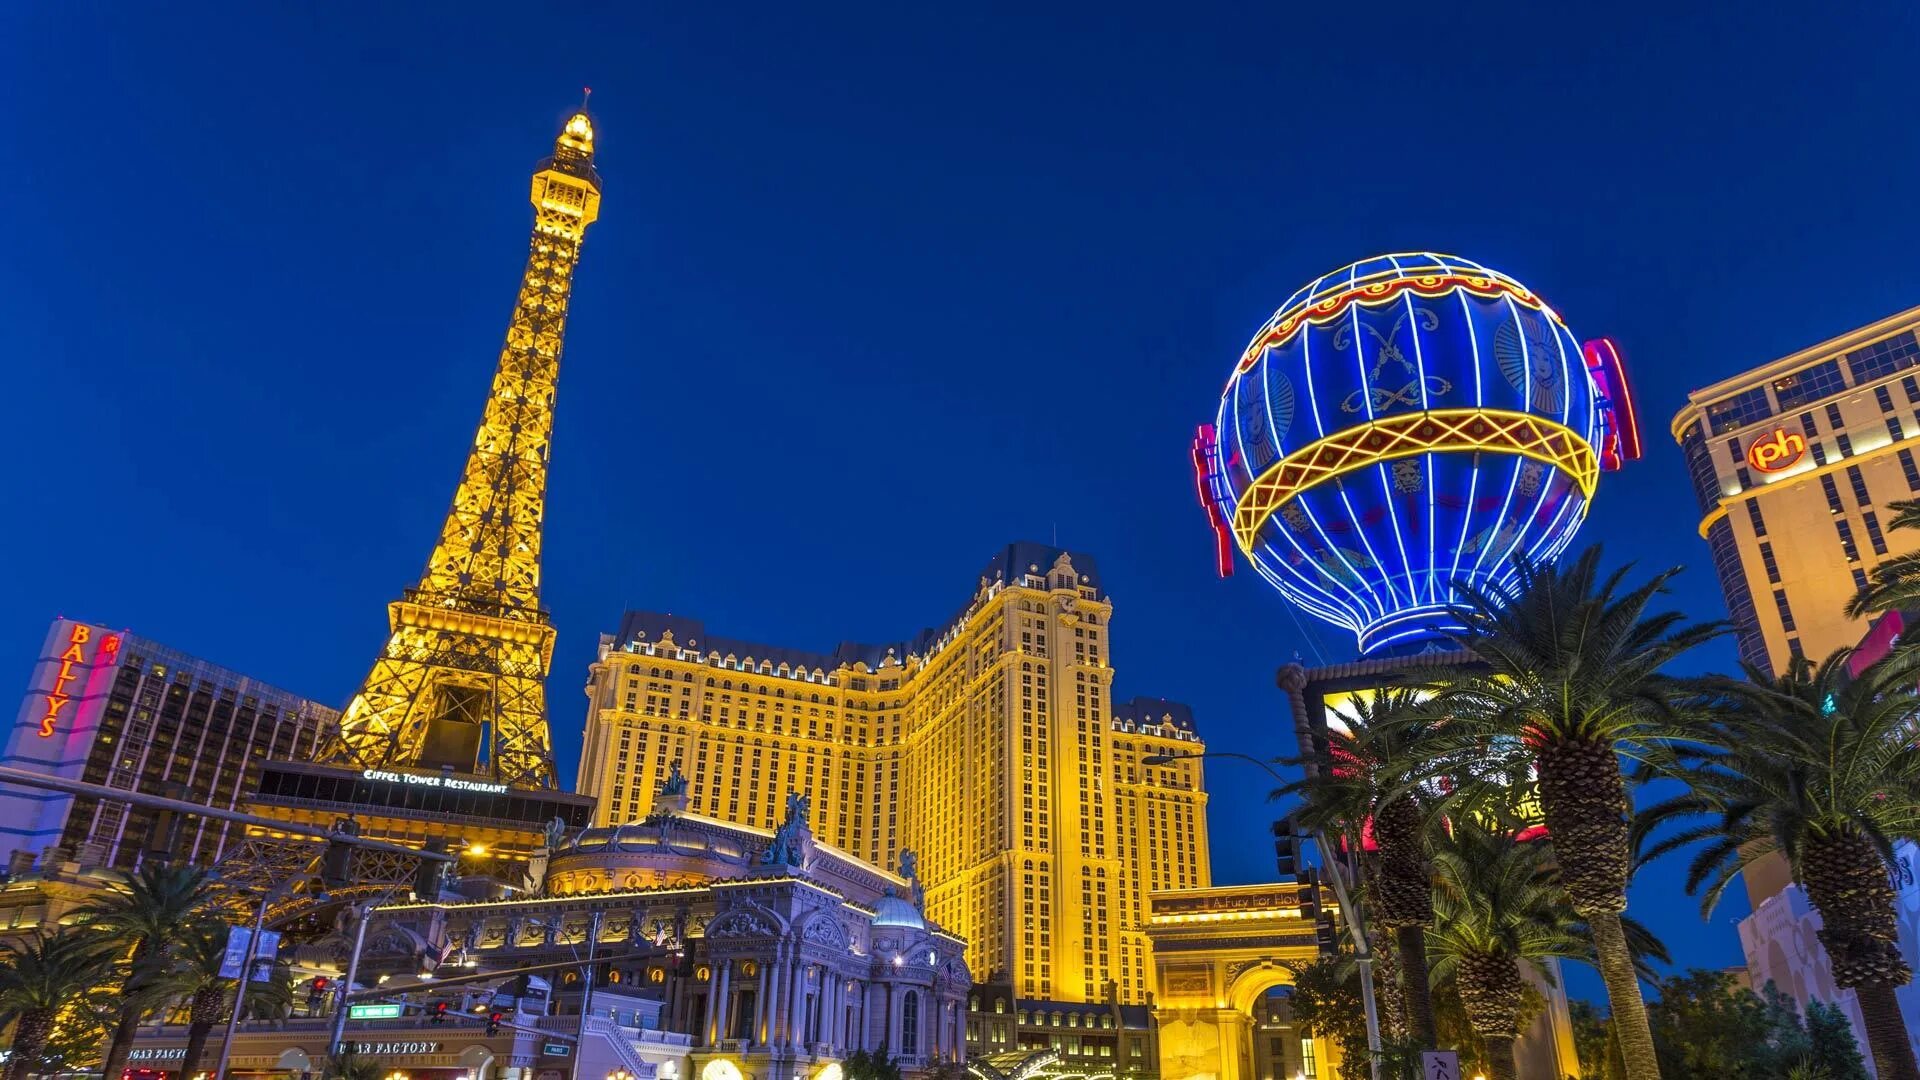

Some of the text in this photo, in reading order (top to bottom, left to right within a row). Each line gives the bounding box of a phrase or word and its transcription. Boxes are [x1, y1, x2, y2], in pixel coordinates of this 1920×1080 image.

[1754, 429, 1804, 469] ph
[363, 770, 508, 794] EIFFEL TOWER RESTAURANT
[375, 1042, 438, 1055] FACTORY
